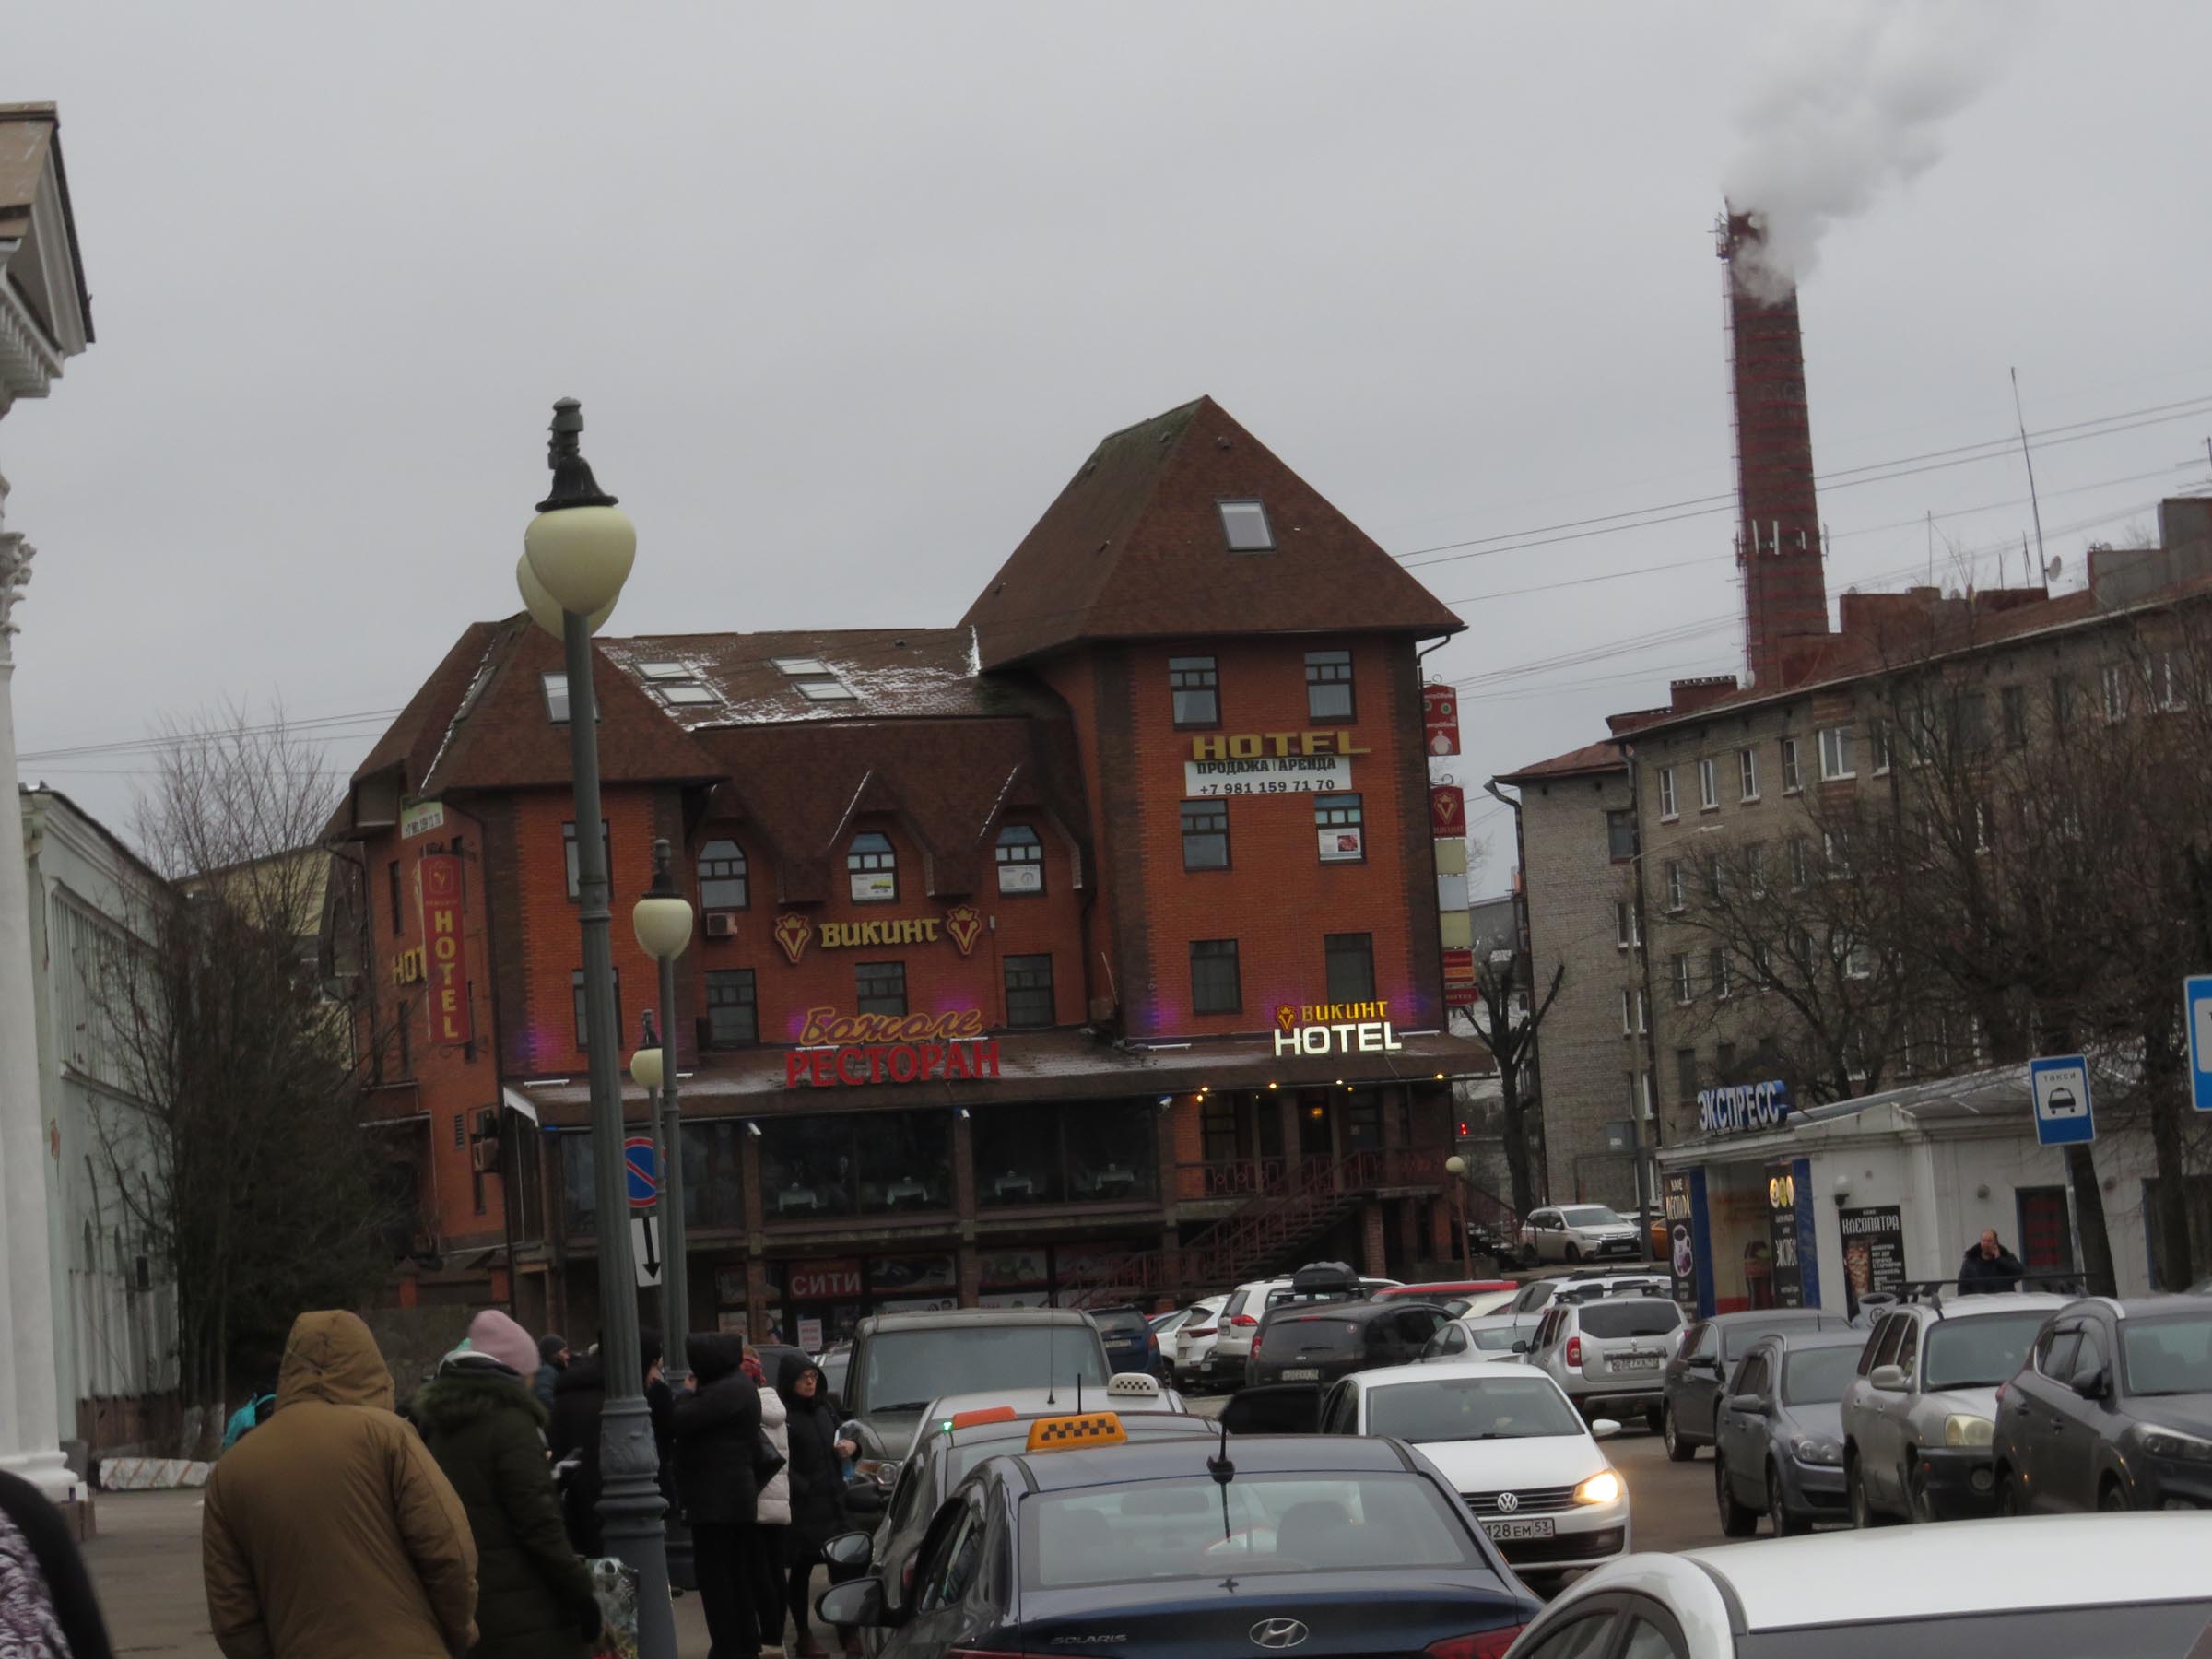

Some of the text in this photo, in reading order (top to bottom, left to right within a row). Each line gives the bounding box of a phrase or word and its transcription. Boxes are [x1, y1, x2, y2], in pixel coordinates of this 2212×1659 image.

[1193, 731, 1371, 759] HOTEL
[1196, 757, 1336, 774] ПРОДАЖА АРЕНДА
[1200, 780, 1335, 794] +7 981 159 71 70
[819, 918, 941, 947] ВИКИНГ
[435, 910, 458, 1038] HOTEL
[799, 1006, 983, 1045] Божоле
[1300, 1001, 1388, 1022] ВИКИНГ
[1274, 1021, 1402, 1056] HOTEL
[784, 1041, 1002, 1088] РЕСТОРАН
[1697, 1082, 1783, 1131] ЭКСПРЕСС
[1841, 1215, 1900, 1234] КЛЕОПАТРА
[791, 1272, 861, 1296] СИТИ
[1050, 1634, 1128, 1644] SOLARIS
